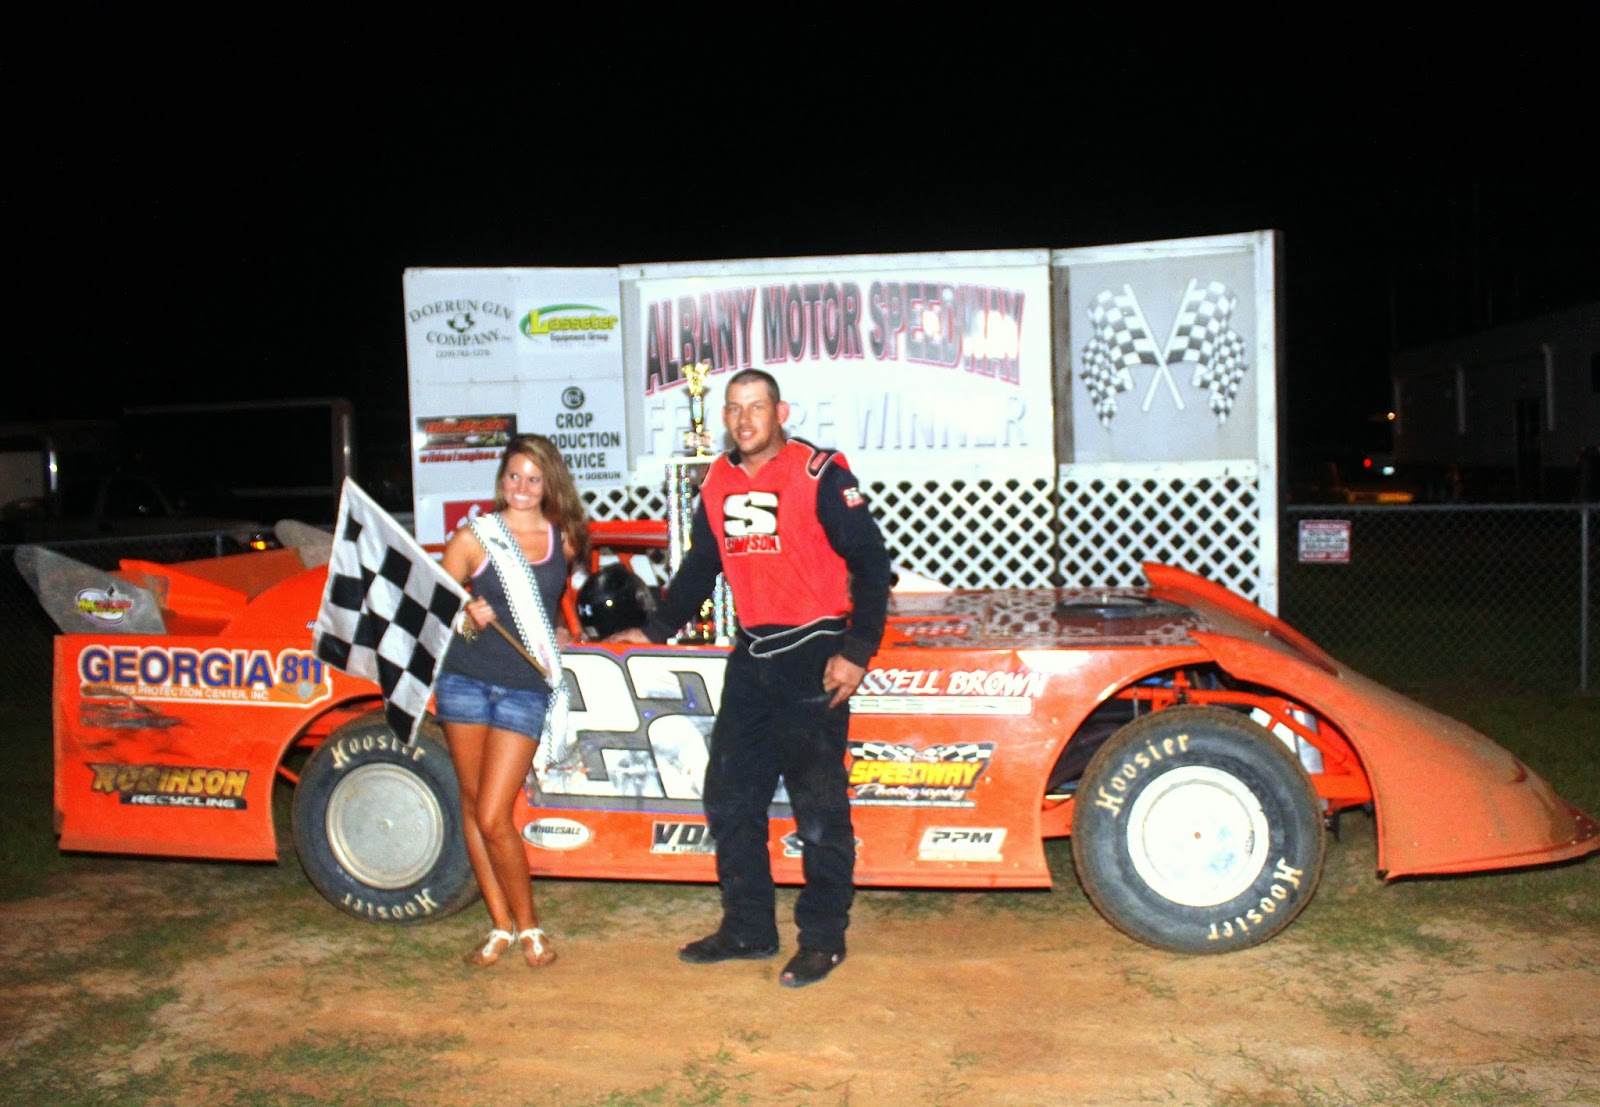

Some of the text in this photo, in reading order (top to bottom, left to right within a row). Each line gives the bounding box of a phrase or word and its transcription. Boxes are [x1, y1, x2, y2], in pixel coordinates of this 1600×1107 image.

[408, 299, 513, 322] DOERUN GIN
[529, 309, 618, 334] Lasseter
[426, 328, 499, 346] COMPANY
[645, 287, 756, 396] ALBANY
[761, 281, 864, 364] MOTOR
[556, 412, 593, 429] CROP
[854, 391, 1029, 450] WINNR
[549, 432, 620, 448] ODUCTION
[564, 452, 606, 468] RVICE
[585, 471, 621, 480] DOERUN
[724, 491, 779, 537] S
[81, 650, 324, 688] GEORGIA 811
[138, 686, 203, 698] PROTECTION
[251, 690, 268, 700] INC
[856, 667, 1048, 698] SSELL BROWN
[90, 763, 248, 795] ROBINSON
[849, 760, 984, 786] SPEEDWAY
[1095, 734, 1189, 817] Hoosier
[130, 794, 236, 808] RECYCLING
[856, 783, 966, 800] Photography
[529, 825, 582, 836] WHOLESALE
[932, 831, 993, 843] PPM
[342, 888, 440, 919] Hoosier
[1207, 857, 1303, 940] Hoosier
